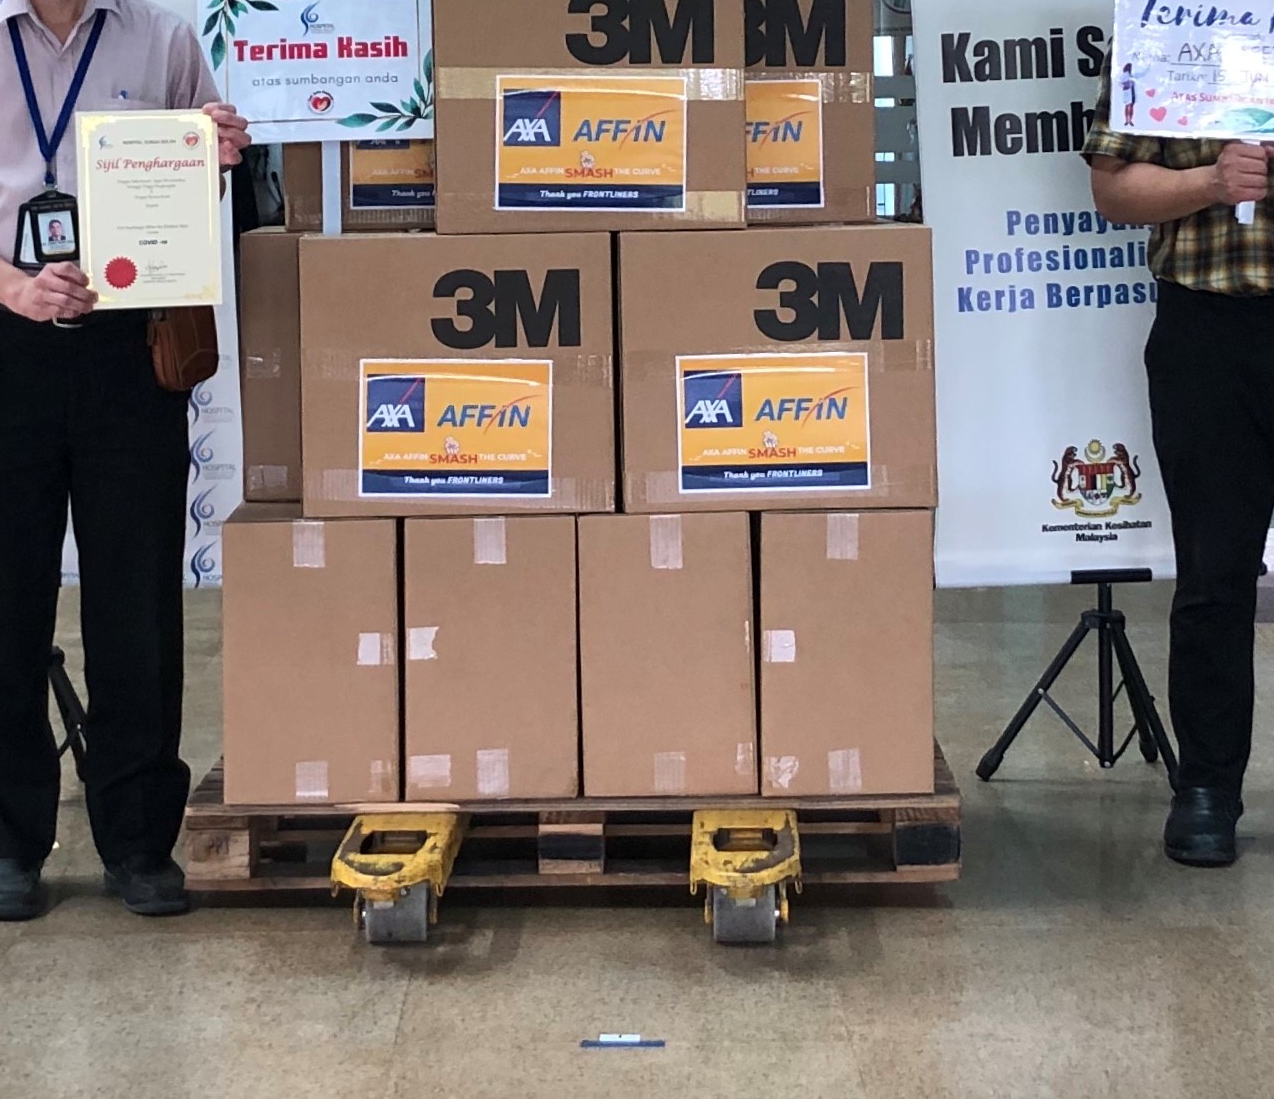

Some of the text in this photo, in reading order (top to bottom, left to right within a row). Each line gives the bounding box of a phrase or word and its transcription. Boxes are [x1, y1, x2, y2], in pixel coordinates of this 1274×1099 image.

[233, 35, 408, 62] Terima Kasih
[941, 28, 1066, 83] Kami
[252, 72, 399, 88] atas sumbangan anda
[503, 118, 552, 143] AXA
[96, 156, 205, 173] Sijil Penghargaan
[565, 167, 614, 179] SMASH
[539, 190, 639, 200] Thank you FRONTLINERS
[753, 261, 904, 342] 3M
[957, 286, 1035, 313] Kerja
[430, 269, 582, 350] 3M
[366, 403, 416, 428] AXA
[685, 399, 733, 424] AXA
[429, 453, 478, 464] SMASH
[748, 447, 797, 459] SMASH
[404, 476, 430, 484] Thank
[447, 475, 504, 484] FRONTLINERS
[723, 470, 749, 479] Thank
[766, 469, 823, 478] FRONTLINERS
[1042, 520, 1152, 533] Kementerian Kesihatan
[1075, 533, 1118, 543] Malaysia
